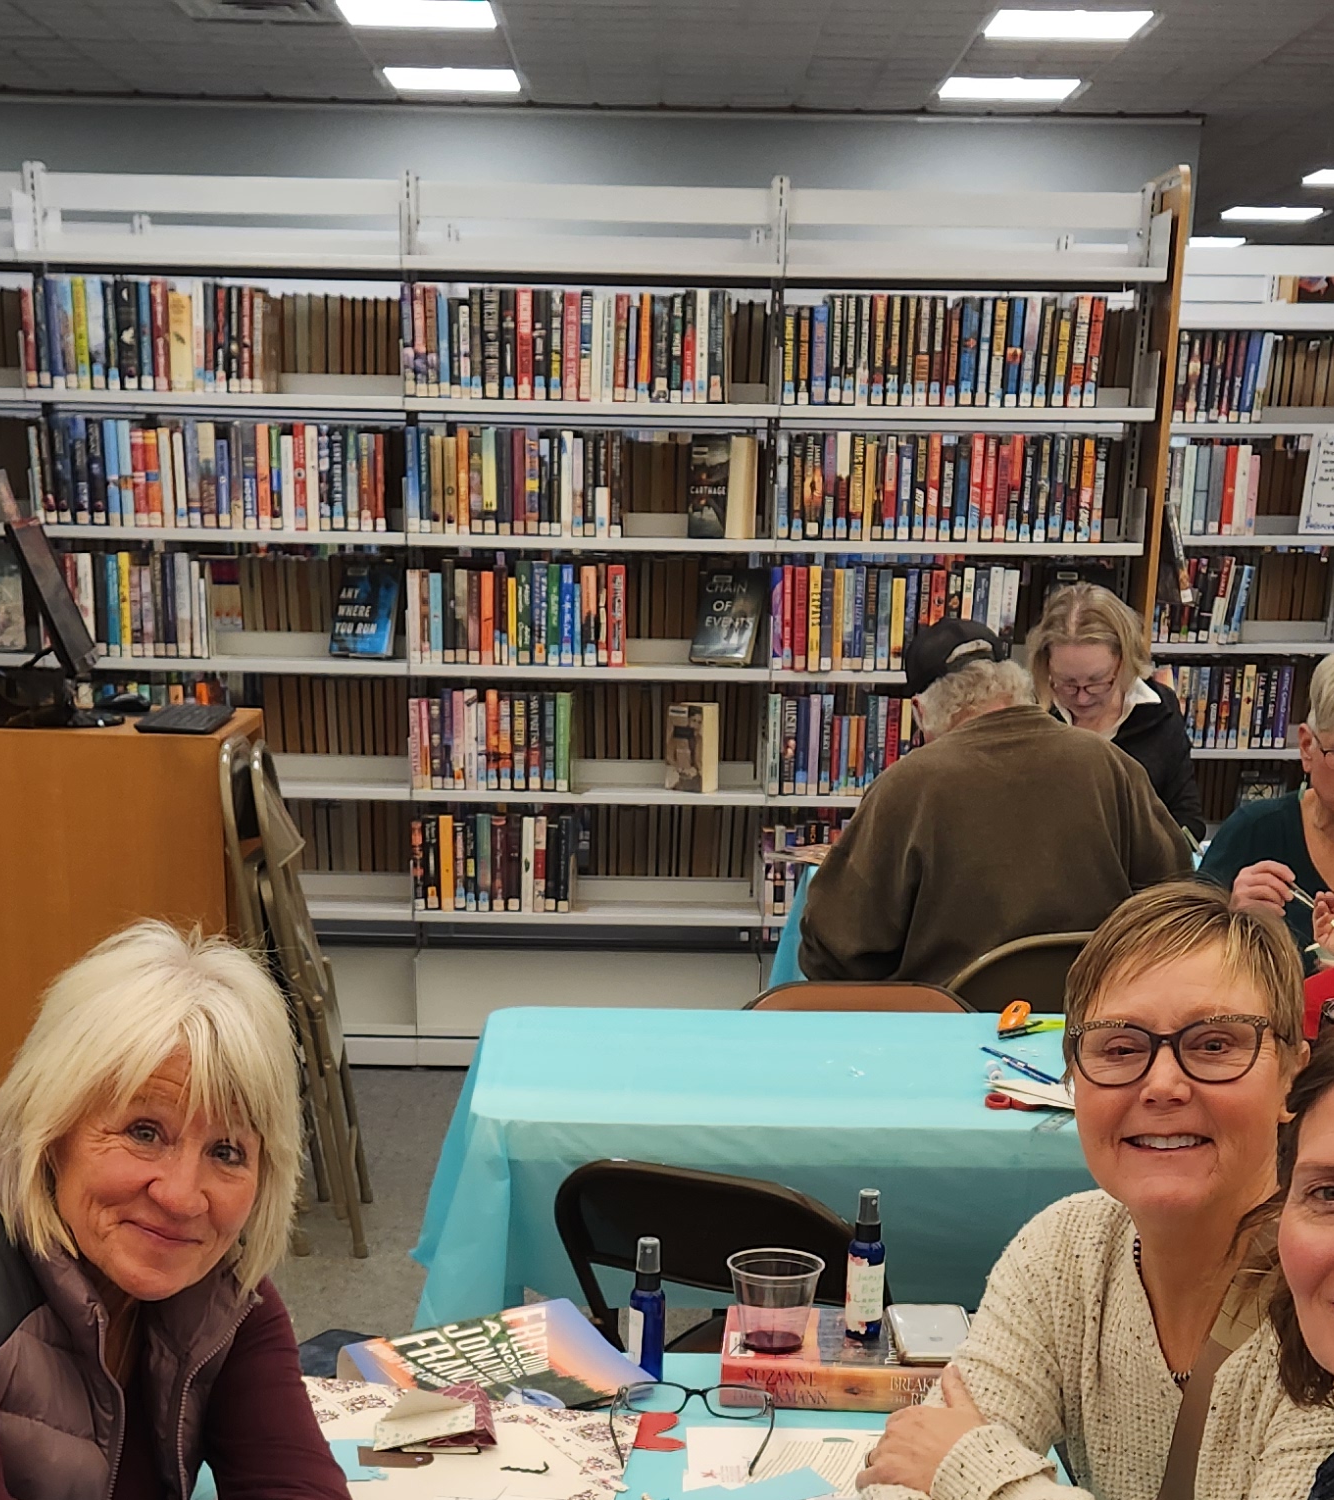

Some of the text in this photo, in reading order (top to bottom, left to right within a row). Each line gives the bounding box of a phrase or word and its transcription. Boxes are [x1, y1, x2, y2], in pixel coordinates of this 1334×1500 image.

[689, 485, 726, 495] CARTHAGE
[340, 587, 359, 599] ANY
[338, 605, 371, 619] WHERE
[712, 600, 732, 611] OF
[483, 1320, 502, 1338] A
[745, 1367, 816, 1387] SUZANNE
